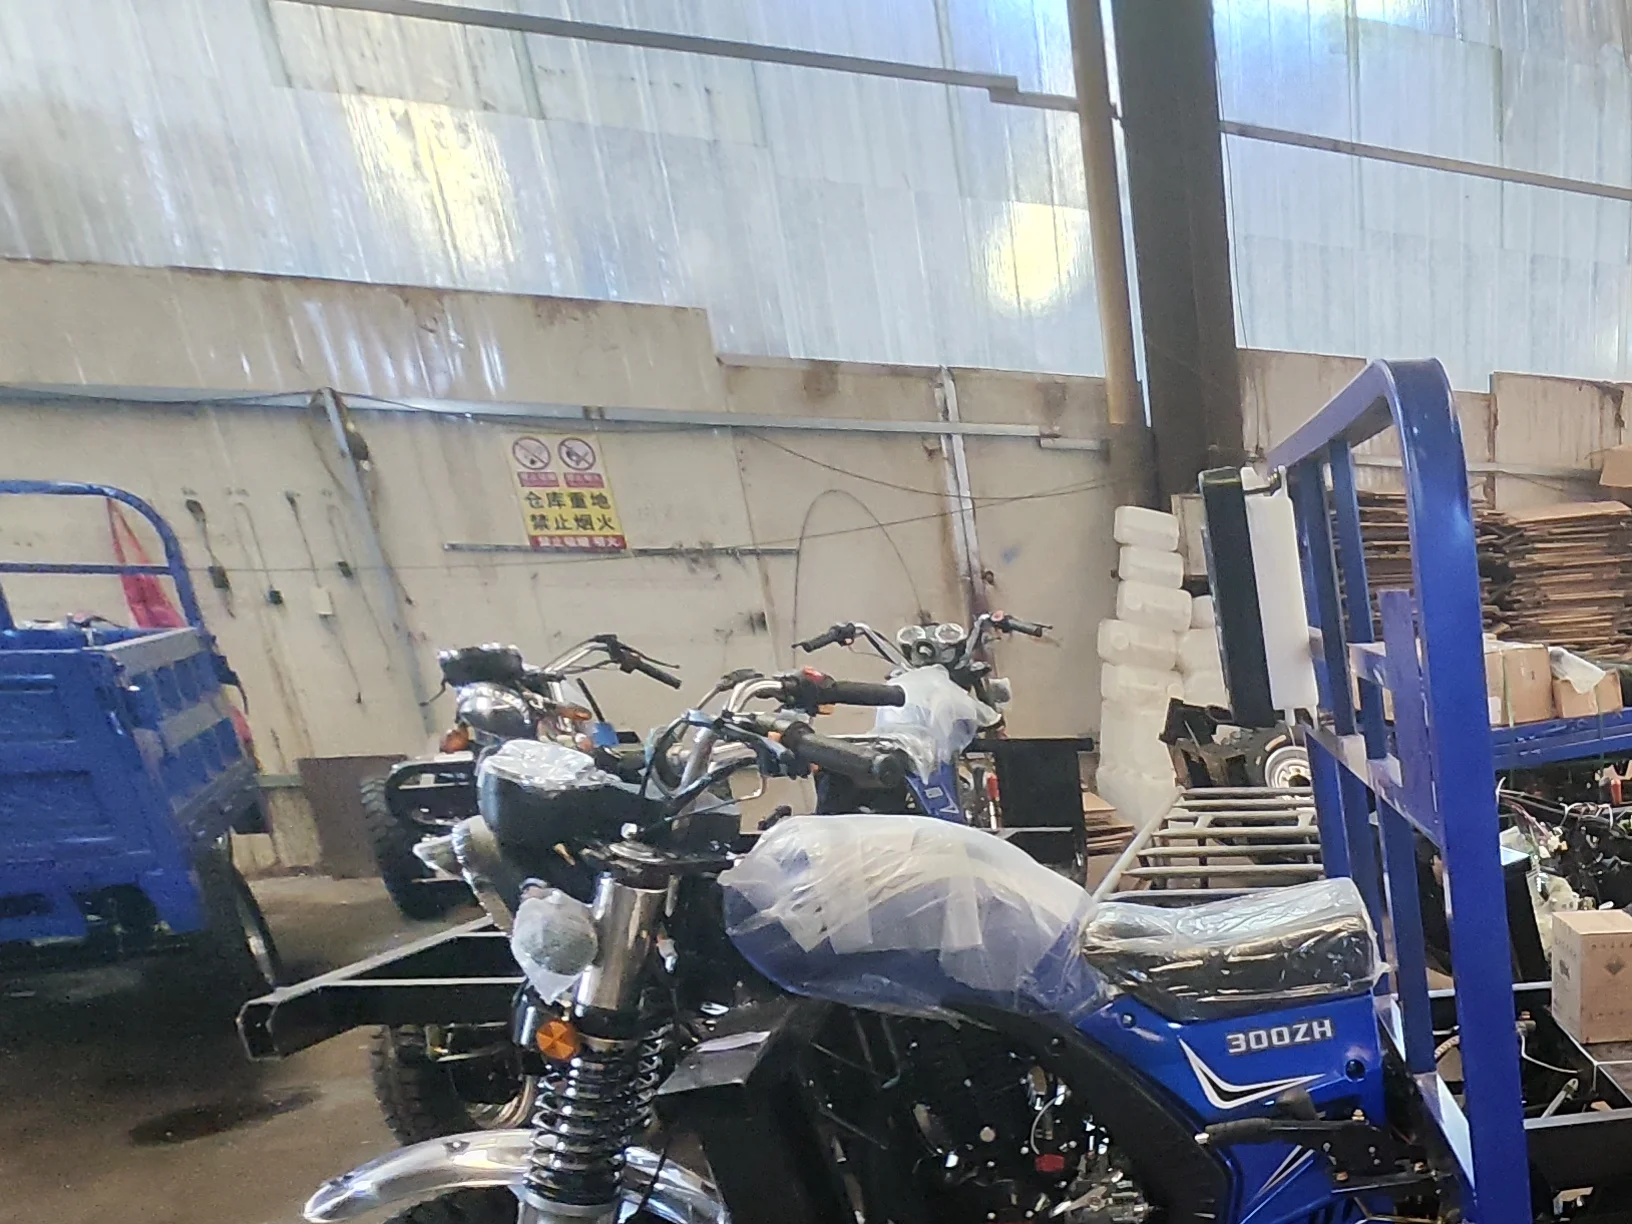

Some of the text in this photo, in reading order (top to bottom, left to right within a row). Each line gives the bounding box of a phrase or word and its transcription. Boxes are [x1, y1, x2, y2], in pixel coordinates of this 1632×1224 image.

[525, 491, 611, 509] 仓库重地
[530, 513, 615, 530] 禁止烟火
[1227, 1018, 1333, 1054] 300ZH
